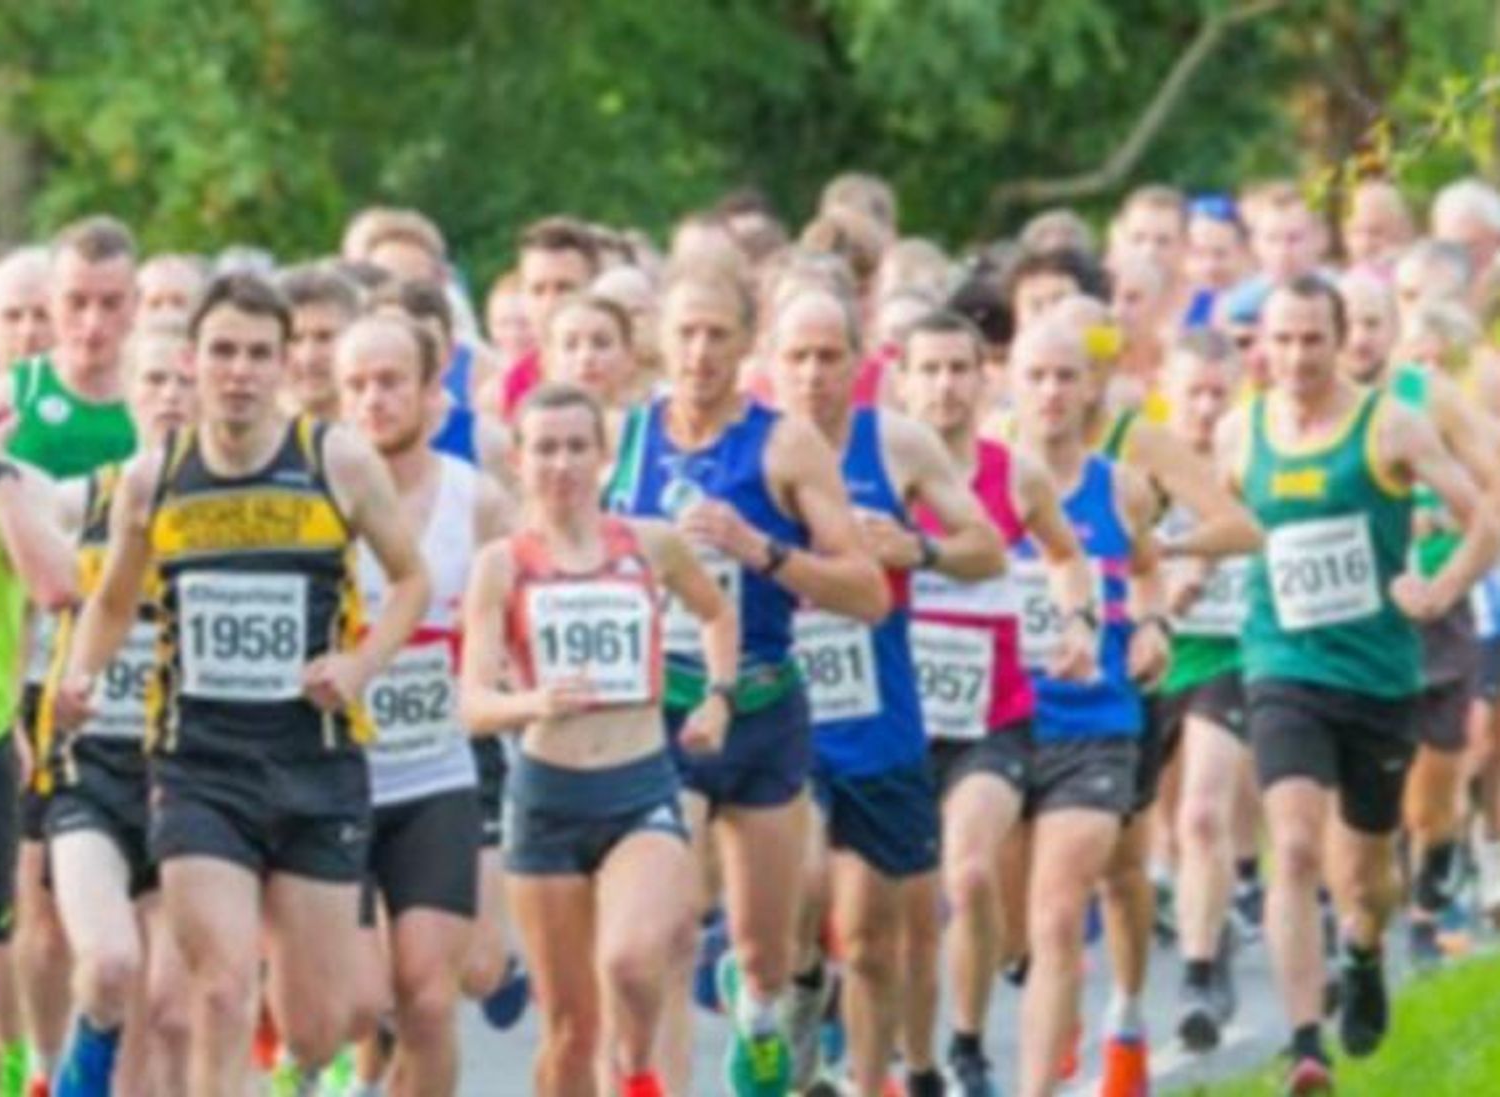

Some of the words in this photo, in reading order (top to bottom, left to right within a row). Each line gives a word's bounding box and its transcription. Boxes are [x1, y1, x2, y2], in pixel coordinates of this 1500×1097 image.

[1276, 548, 1369, 597] 2016
[189, 613, 298, 662] 1958
[538, 618, 641, 667] 1961
[372, 678, 450, 728] 962
[918, 660, 985, 704] 957
